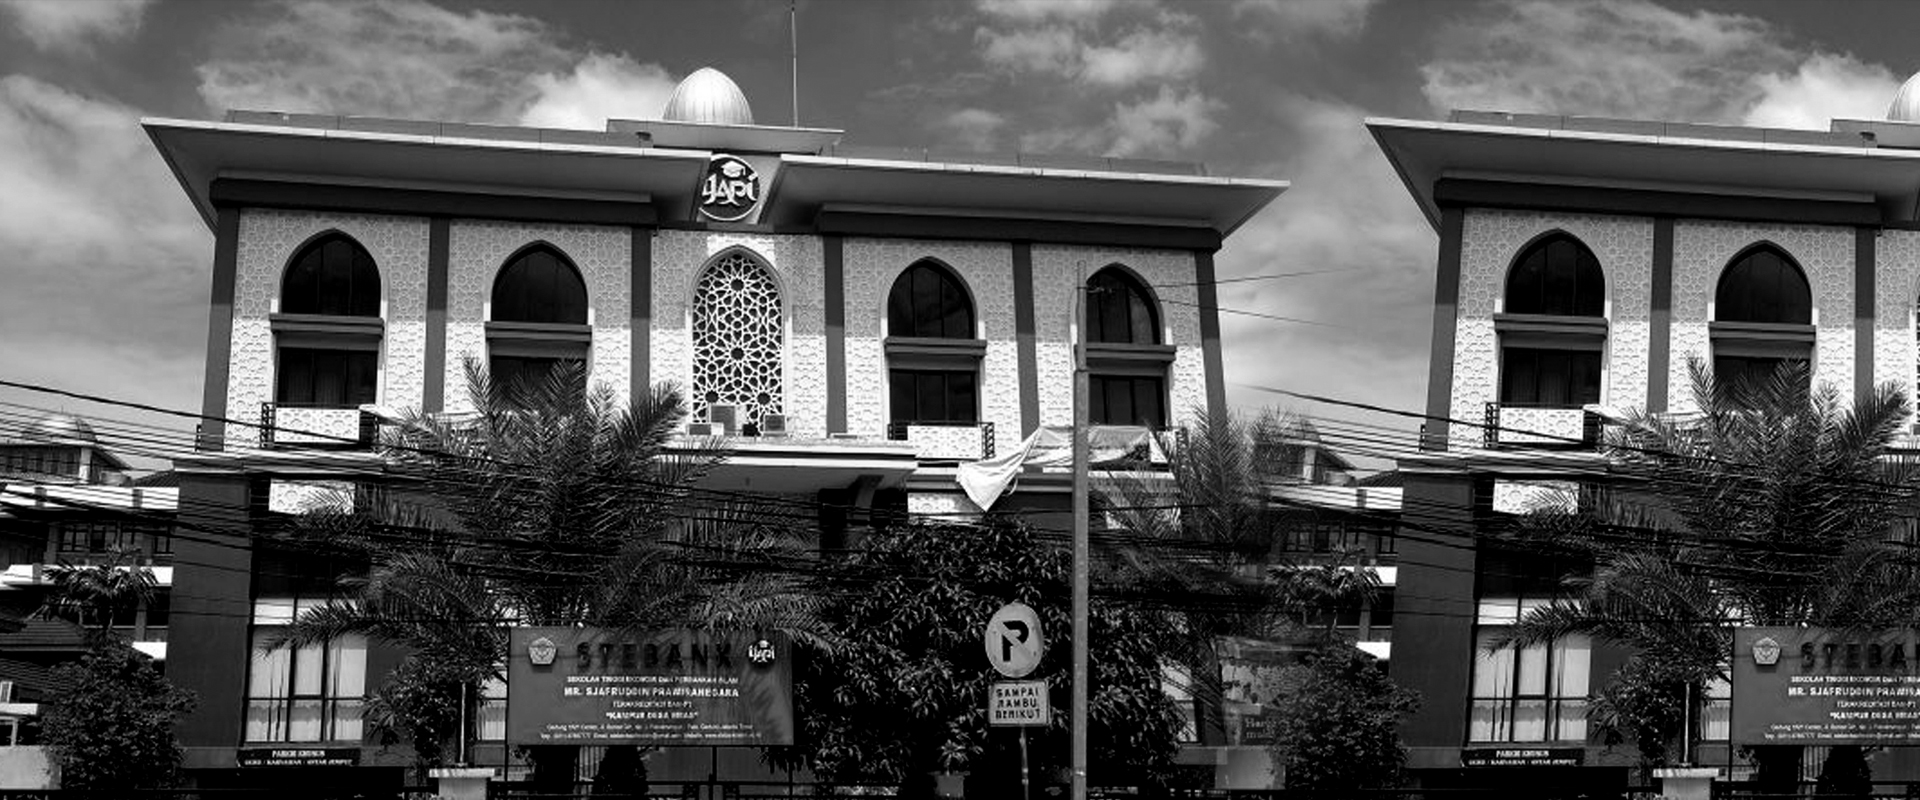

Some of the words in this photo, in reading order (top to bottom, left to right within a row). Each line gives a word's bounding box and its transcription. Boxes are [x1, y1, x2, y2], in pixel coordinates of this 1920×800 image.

[577, 642, 732, 668] STEBANK
[564, 686, 583, 696] MR.
[586, 686, 649, 696] SJAFRUDDIN
[996, 688, 1038, 698] SAMPAI
[1788, 686, 1807, 696] MR.
[1810, 686, 1873, 696] SJAFRUDDIN
[997, 698, 1037, 708] RAMBU
[995, 709, 1040, 719] BERIKUT
